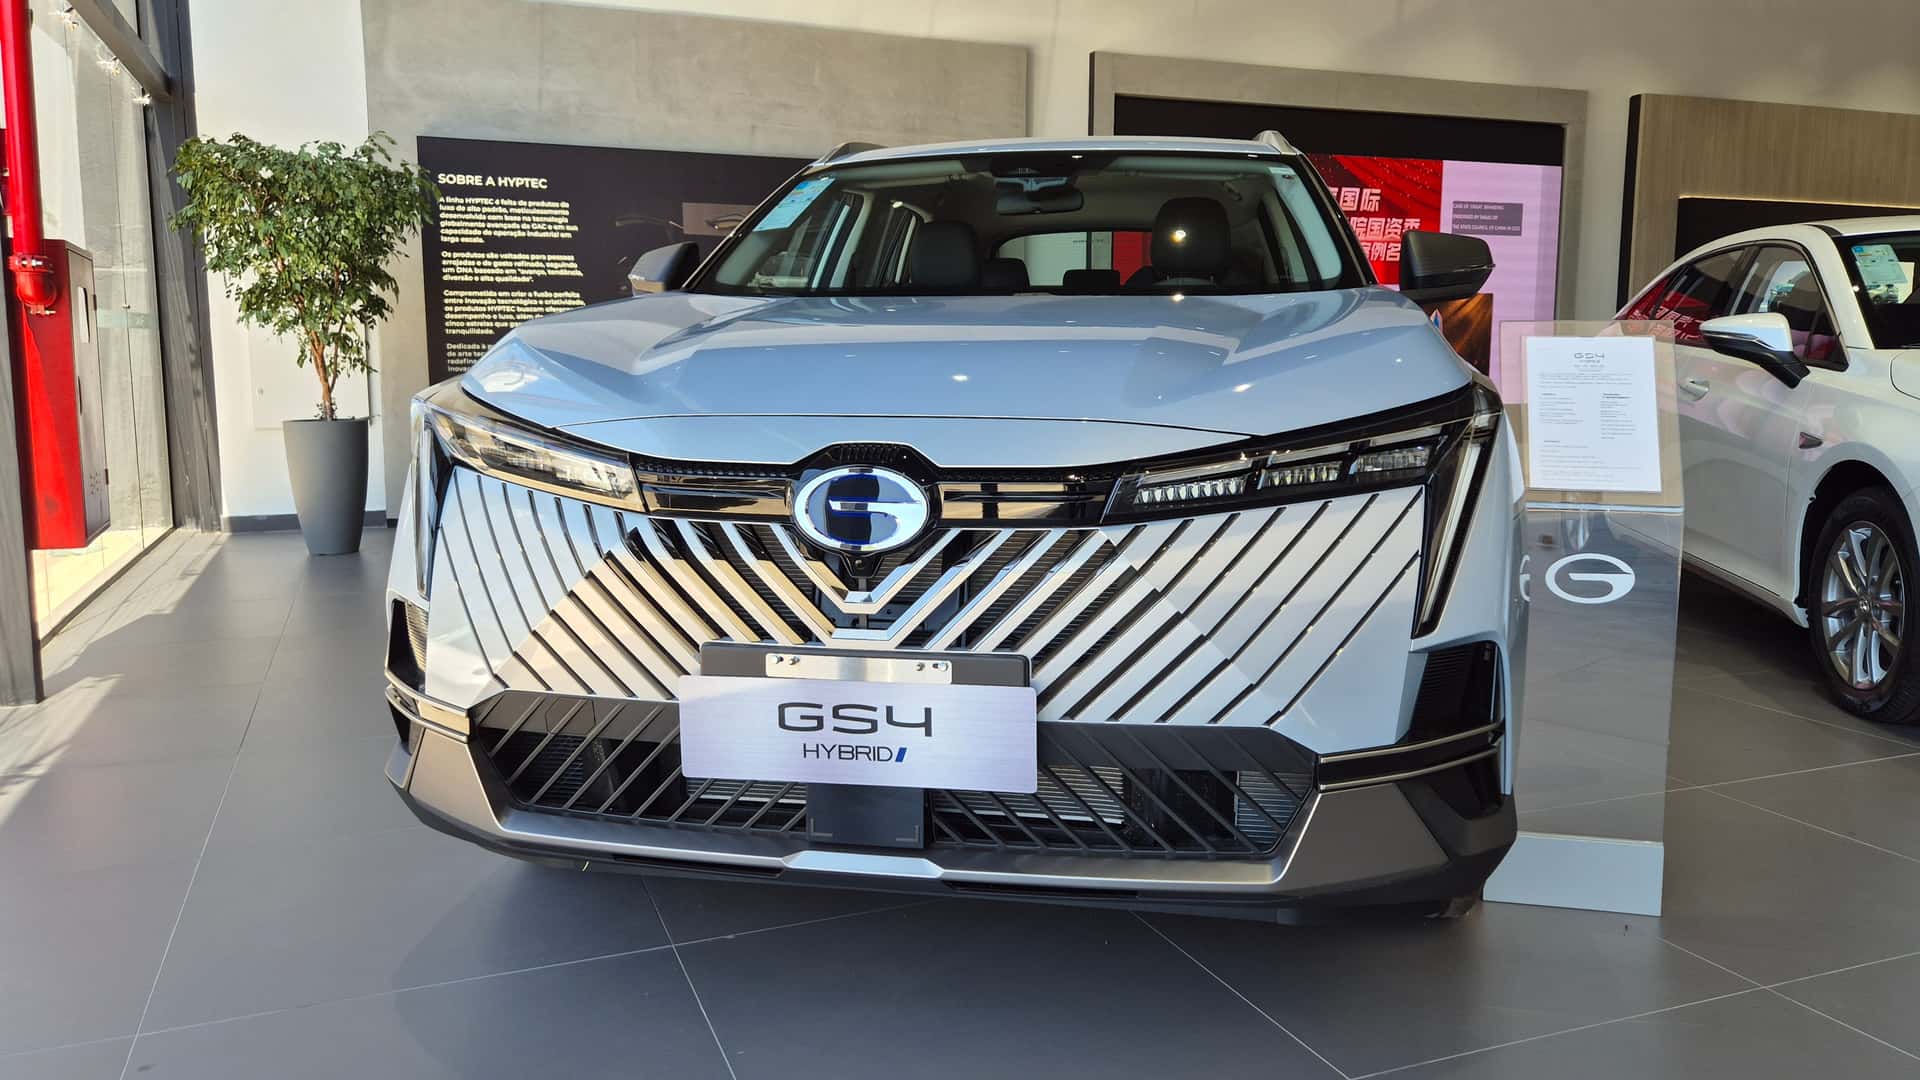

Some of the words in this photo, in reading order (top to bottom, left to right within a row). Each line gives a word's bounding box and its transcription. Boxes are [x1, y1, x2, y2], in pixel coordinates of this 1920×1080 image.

[438, 174, 483, 186] SOBRE
[485, 176, 495, 186] A
[498, 176, 548, 189] HYPTEC
[446, 196, 464, 204] linha
[453, 251, 485, 260] produtos
[474, 267, 504, 275] baseado
[465, 298, 496, 306] inovação
[455, 305, 486, 313] produtos
[445, 312, 491, 320] desempenho
[778, 702, 932, 737] GS4
[803, 744, 893, 763] HYBRID
